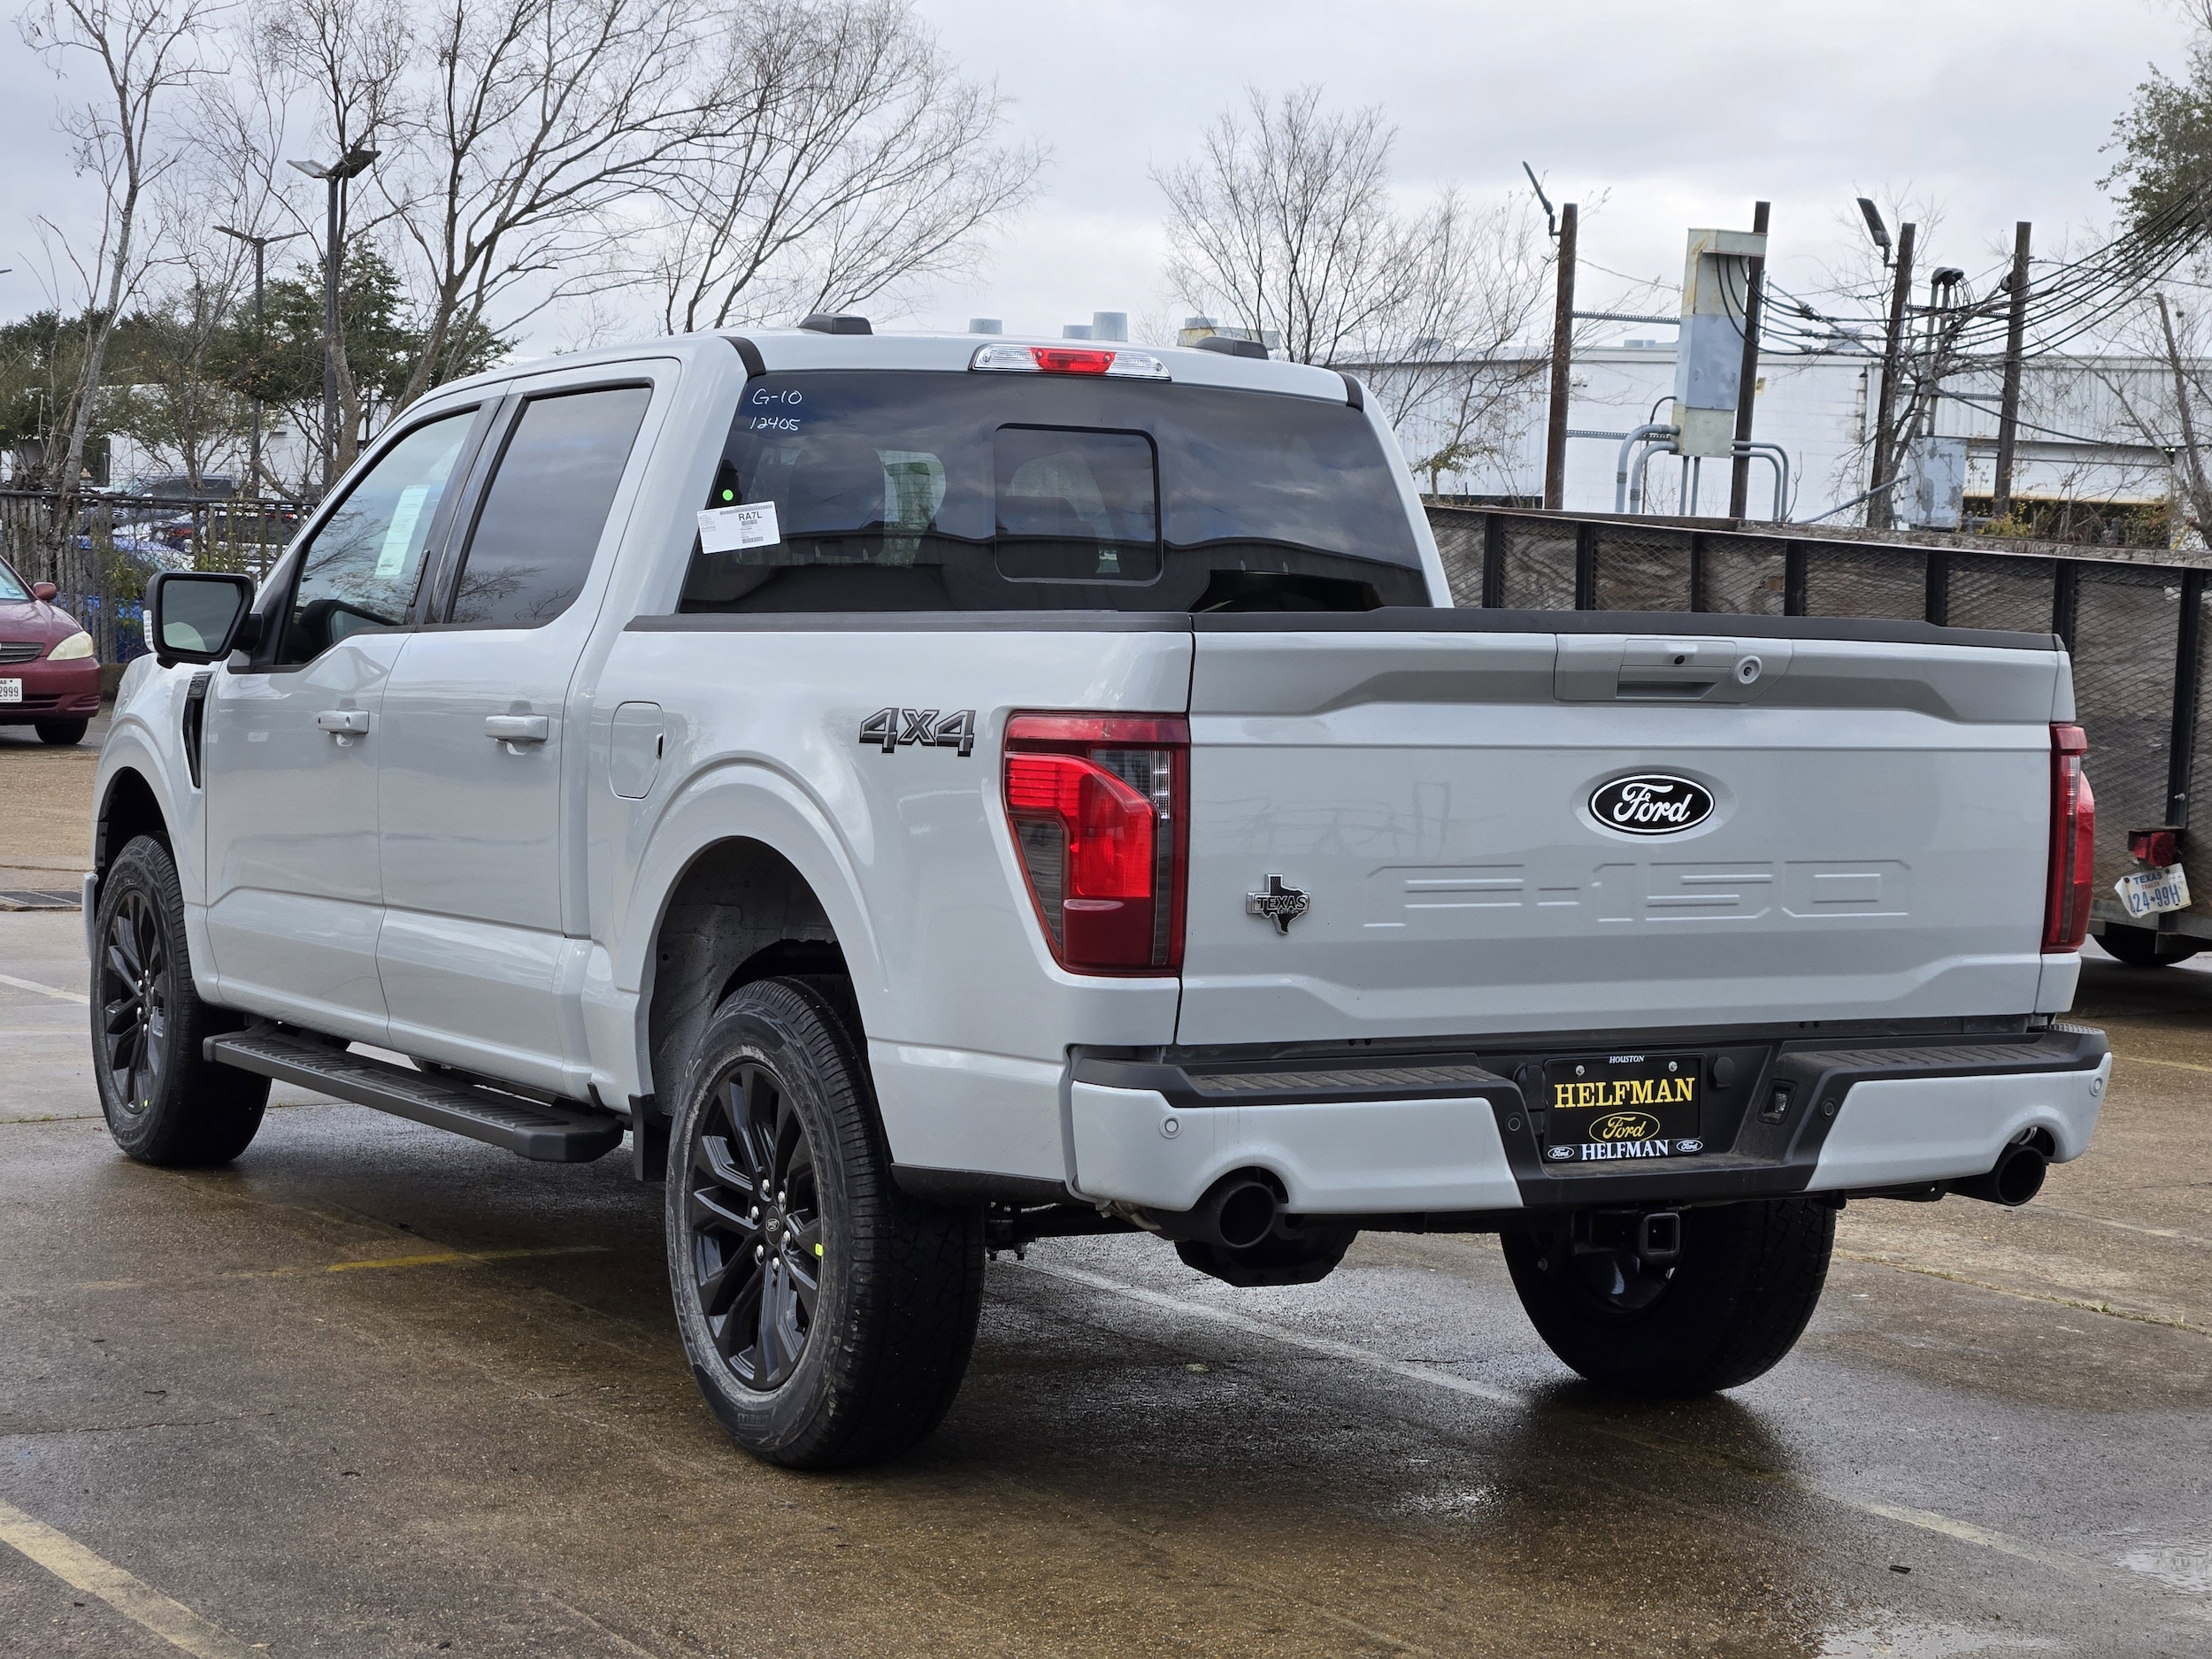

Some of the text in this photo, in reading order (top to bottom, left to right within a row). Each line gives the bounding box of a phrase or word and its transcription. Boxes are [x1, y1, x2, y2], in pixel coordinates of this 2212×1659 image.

[752, 388, 803, 404] G-10
[749, 417, 801, 431] 12405
[738, 511, 763, 521] RA7L
[1613, 783, 1694, 823] Ford
[2132, 872, 2162, 885] TEXAS
[1256, 895, 1307, 910] TEXAS
[1554, 1077, 1696, 1109] HELFMAN
[1602, 1116, 1647, 1140] Ford
[1552, 1140, 1700, 1161] Ford HELFMAN Ford
